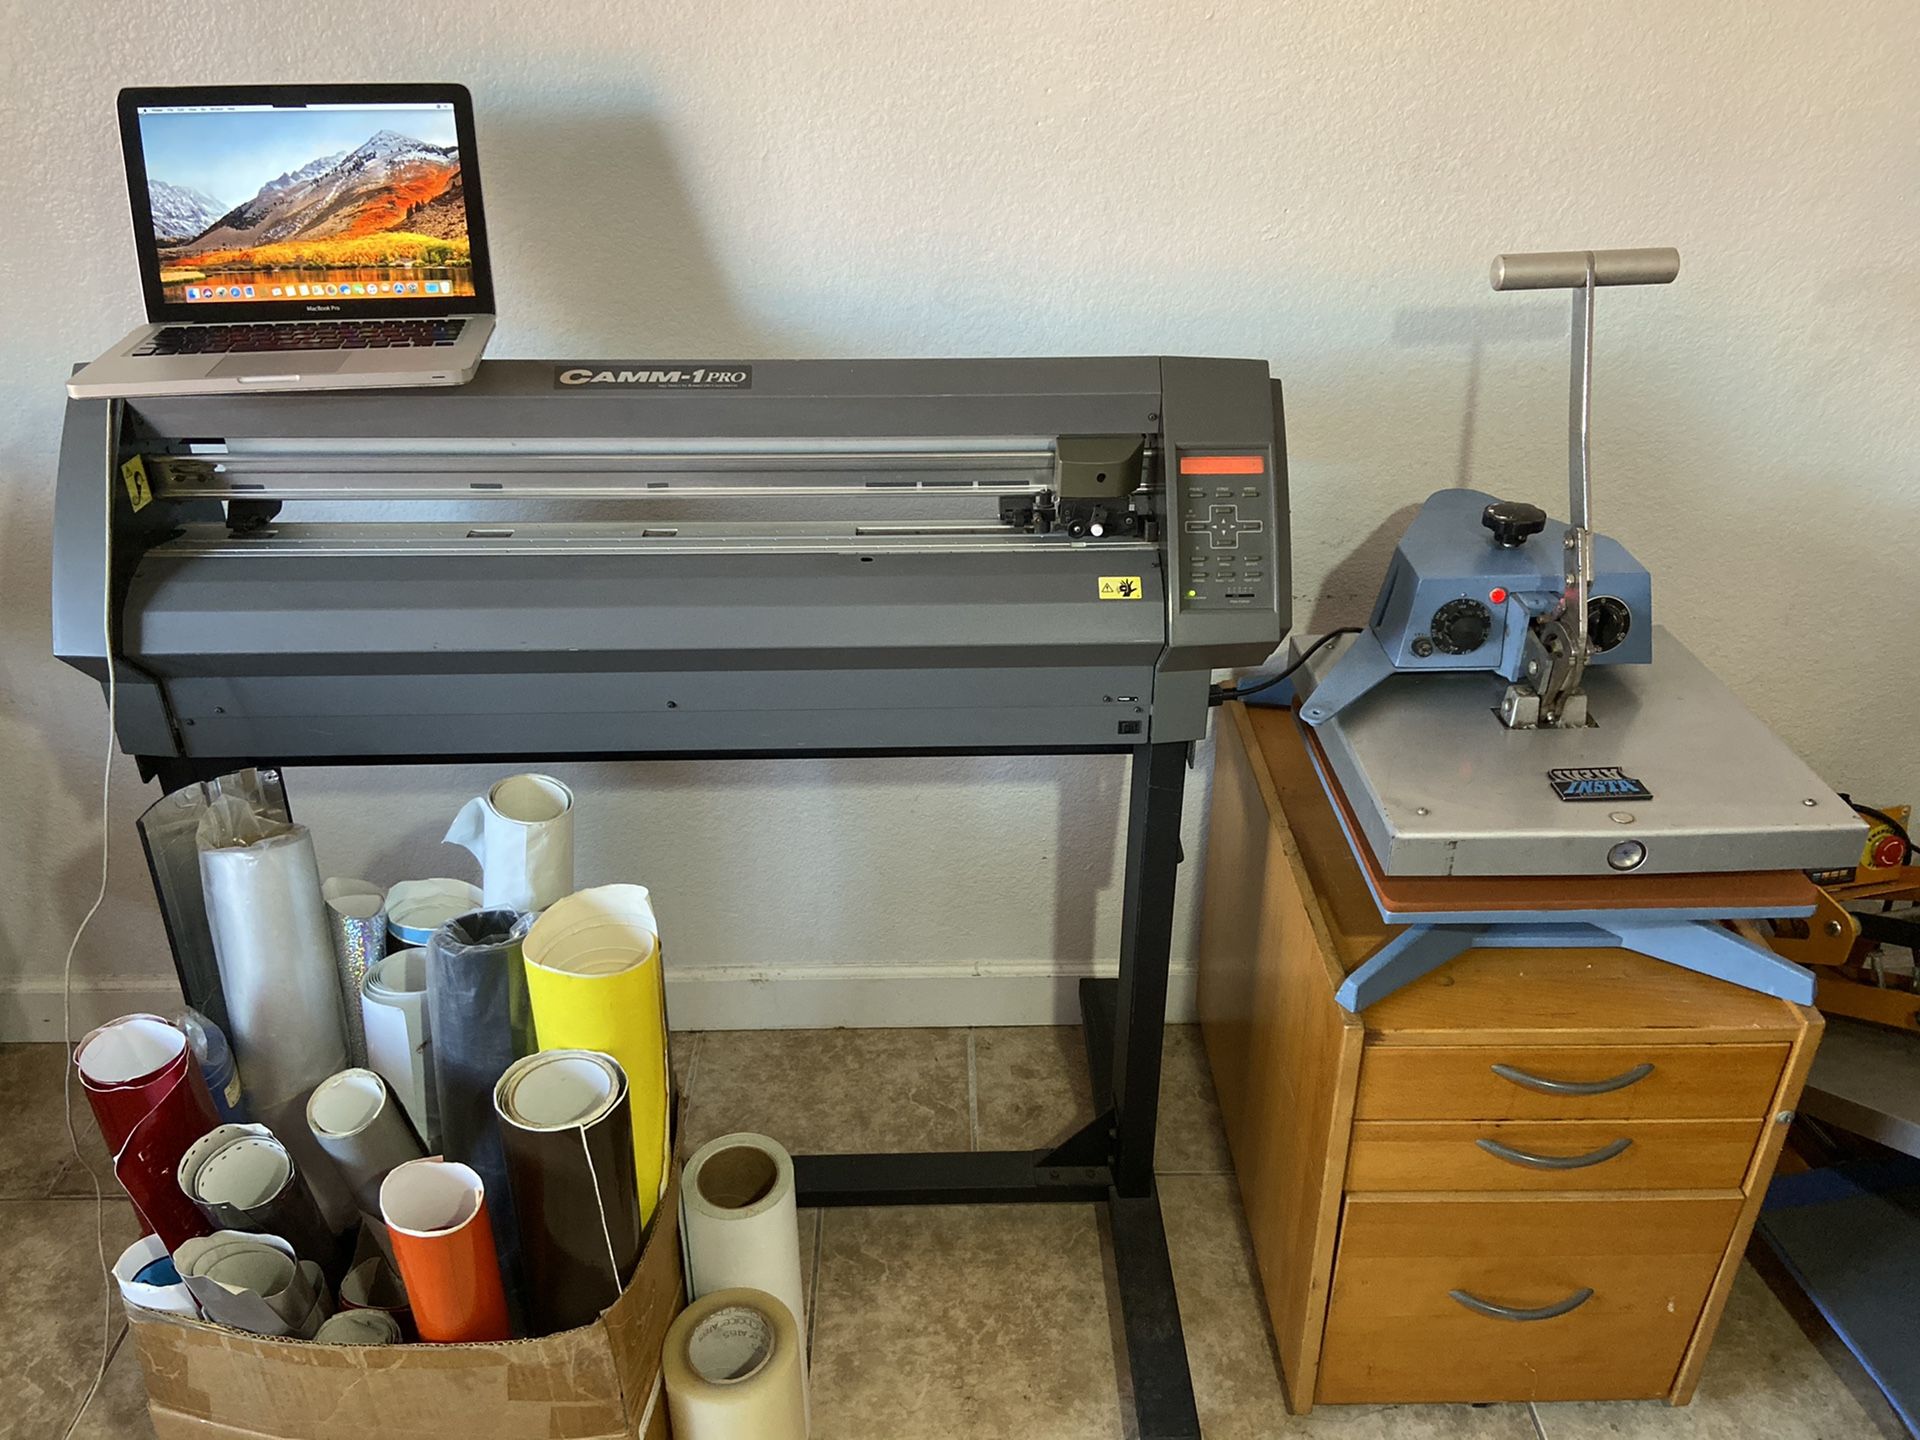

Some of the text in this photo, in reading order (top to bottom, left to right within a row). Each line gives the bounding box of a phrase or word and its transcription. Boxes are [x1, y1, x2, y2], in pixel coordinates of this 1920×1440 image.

[559, 369, 747, 385] CAMM-1 PRO
[1563, 780, 1640, 794] INSTA
